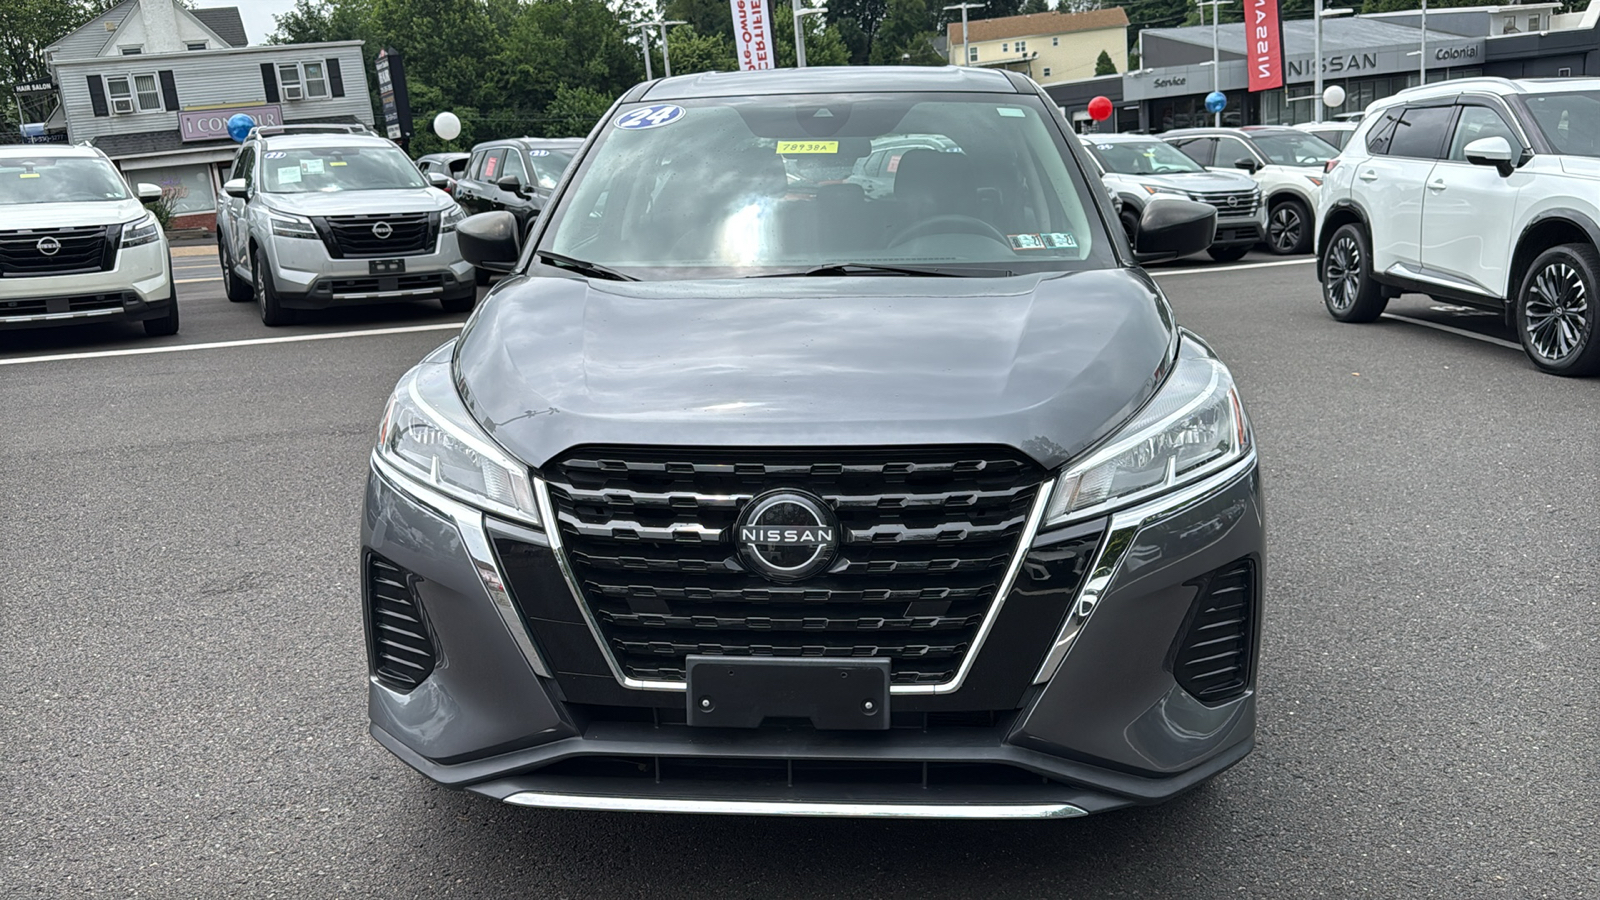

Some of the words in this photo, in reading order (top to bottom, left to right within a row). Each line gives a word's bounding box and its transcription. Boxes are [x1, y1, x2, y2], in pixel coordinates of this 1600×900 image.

[1436, 45, 1478, 60] Colonial
[16, 84, 31, 92] HAIR
[31, 83, 52, 91] SALON
[1153, 76, 1186, 88] Service
[620, 105, 678, 127] 24
[742, 529, 832, 542] NISSAN
